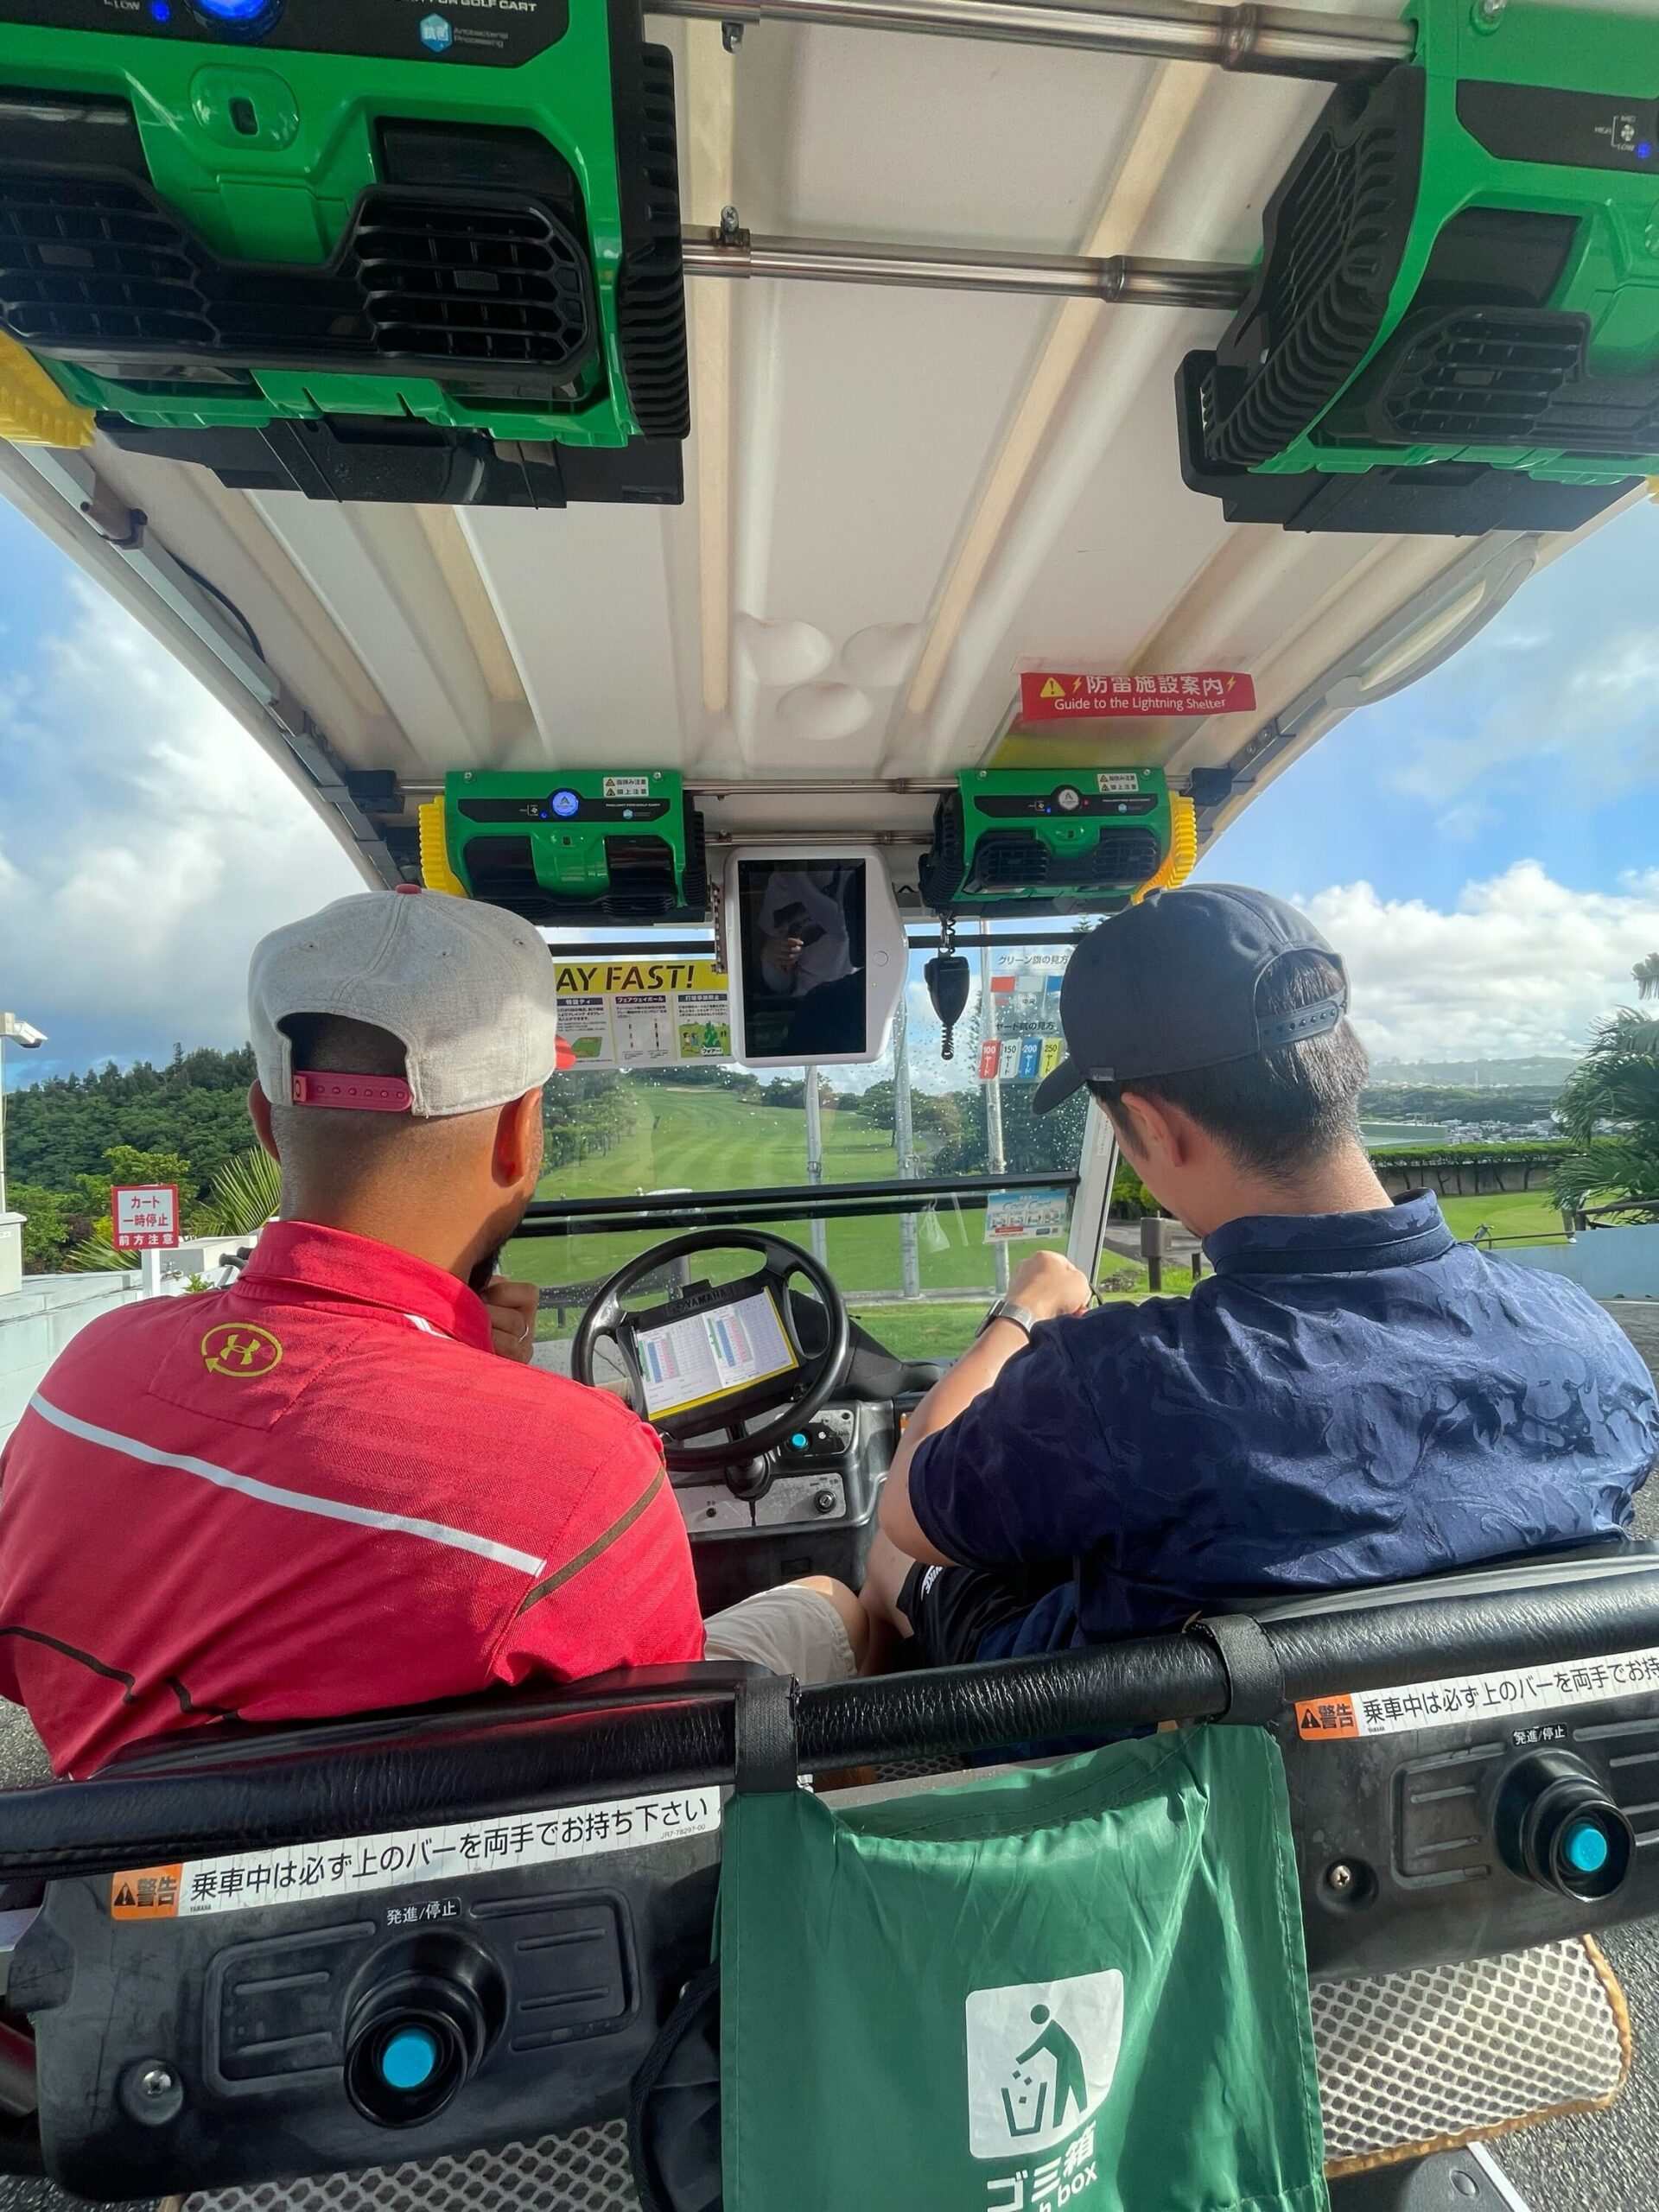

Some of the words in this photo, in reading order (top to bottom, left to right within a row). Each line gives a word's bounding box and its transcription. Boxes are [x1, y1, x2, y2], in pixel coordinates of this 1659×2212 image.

[499, 0, 537, 12] CART
[1054, 698, 1090, 710] Guide
[1094, 698, 1107, 709] to
[1110, 696, 1129, 709] the
[1132, 696, 1184, 711] Lightning
[1186, 697, 1226, 709] Shelter
[998, 955, 1069, 965] グリーン旗の見方
[606, 964, 695, 991] FAST!
[983, 1046, 996, 1054] 100
[1004, 1045, 1017, 1053] 150
[1023, 1044, 1038, 1053] 200
[1044, 1044, 1058, 1052] 250
[130, 1195, 161, 1209] カート
[123, 1213, 169, 1227] 一時停止
[118, 1233, 174, 1247] 前方注意
[685, 1288, 728, 1308] YAMAHA
[1319, 1703, 1354, 1730] 警告
[1363, 1656, 1659, 1725] 乗車中は必ず上のバーを両手でお持
[1512, 1725, 1566, 1745] 発進/停止
[137, 1877, 178, 1906] 警告
[189, 1796, 709, 1902] 乗車中は必ず上のバーを両手でお持ち下さい
[386, 1900, 457, 1926] 発進/停止
[987, 2120, 1096, 2212] ゴミ箱
[1058, 2161, 1097, 2208] box
